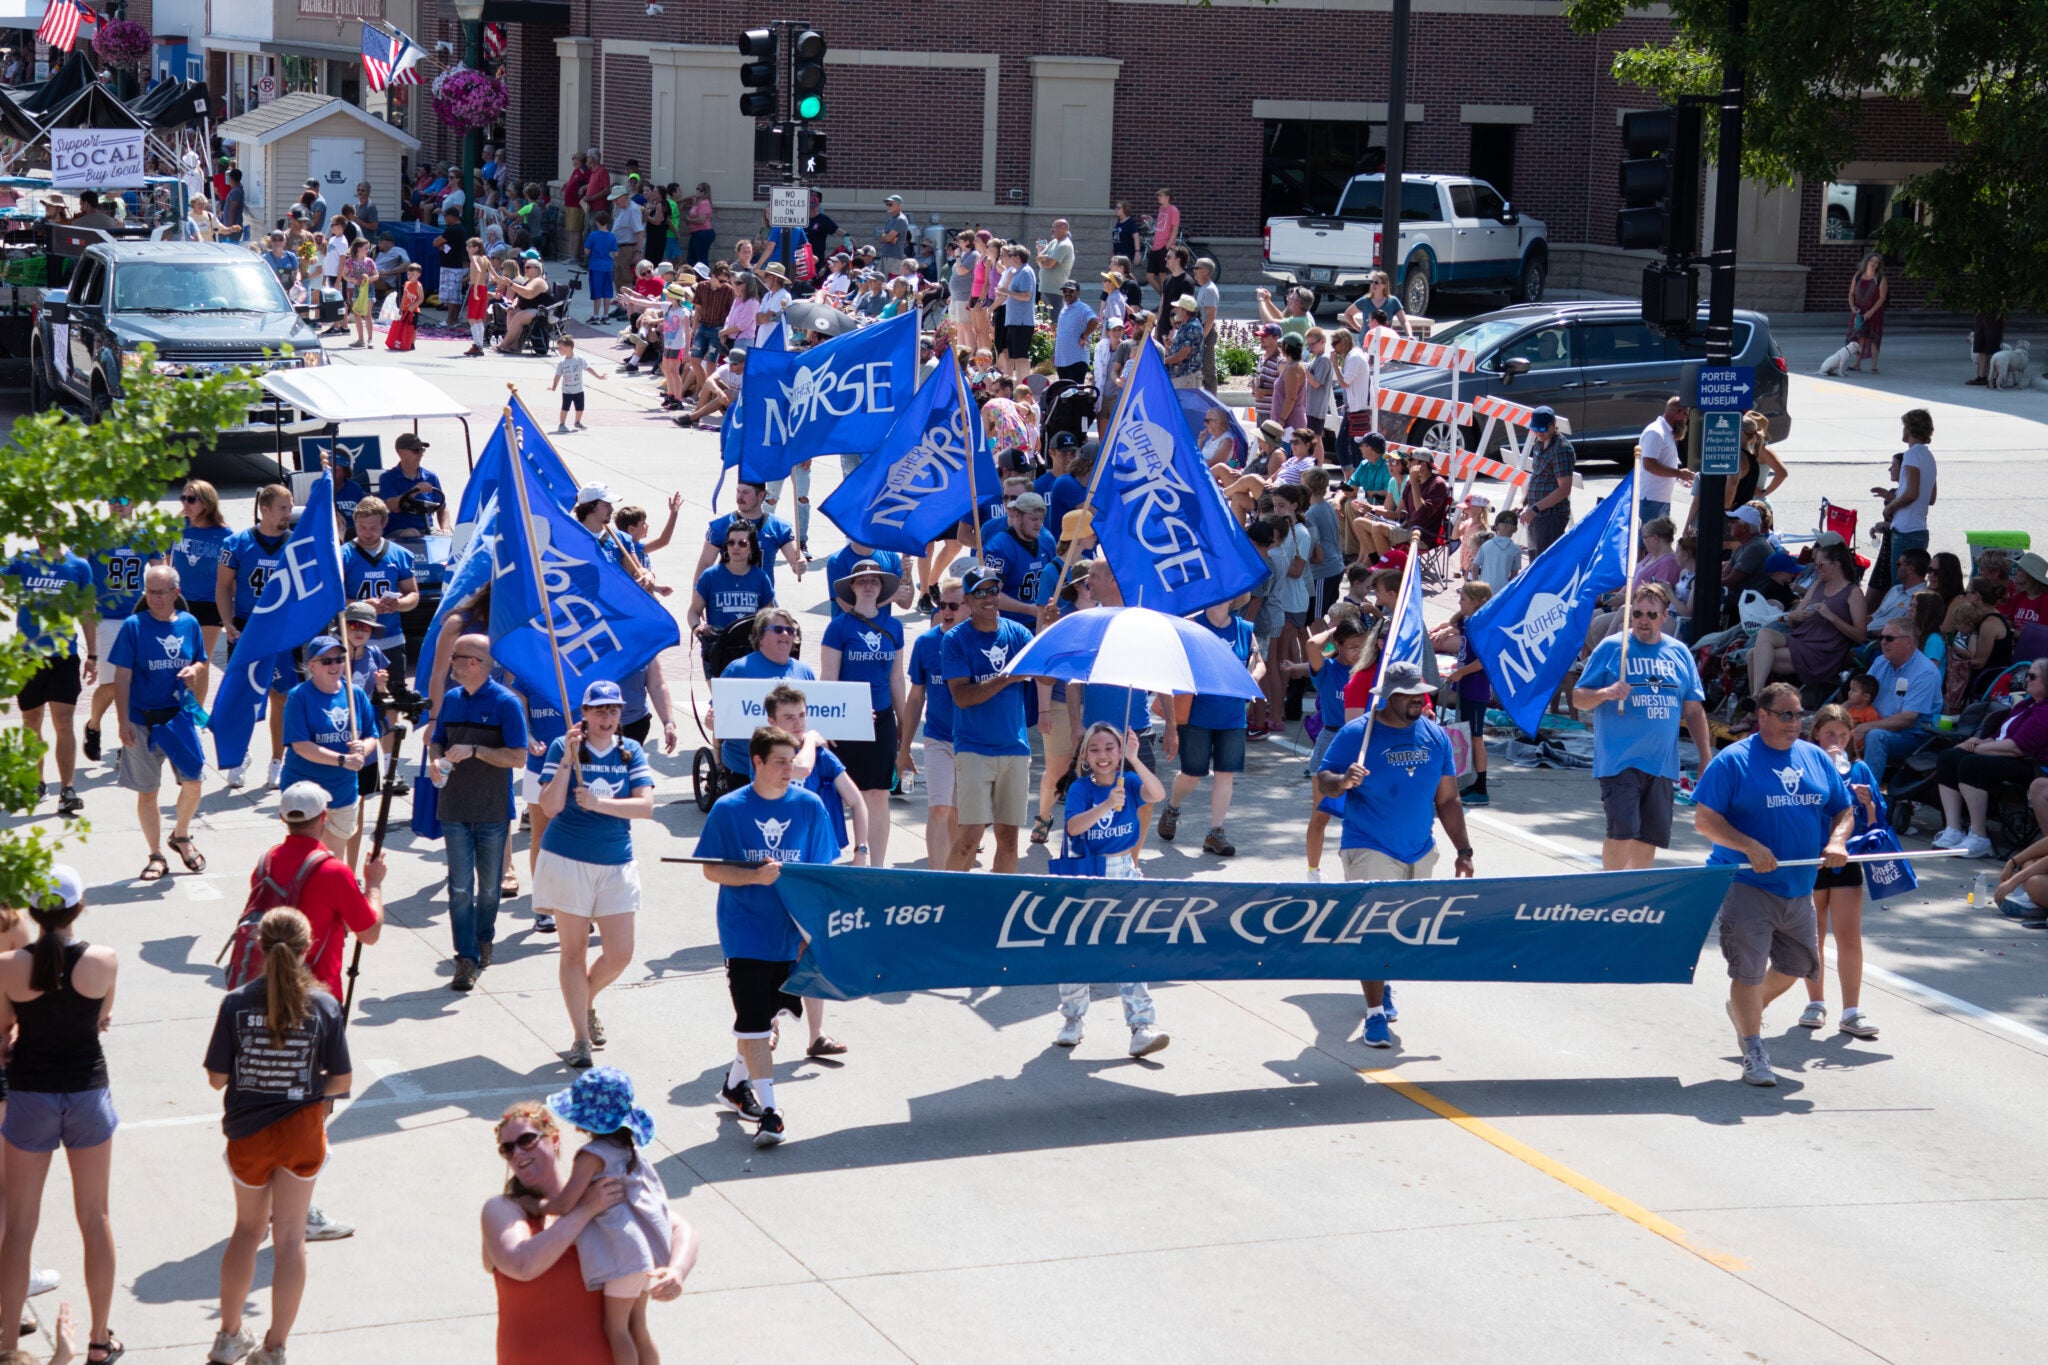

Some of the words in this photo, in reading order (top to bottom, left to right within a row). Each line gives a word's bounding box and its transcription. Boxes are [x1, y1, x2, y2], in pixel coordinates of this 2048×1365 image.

[55, 134, 100, 153] Support
[56, 144, 138, 170] LOCAL
[85, 168, 108, 183] Buy
[111, 161, 141, 178] Local
[785, 190, 795, 198] NO
[774, 199, 806, 207] BICYCLES
[773, 216, 805, 224] SIDEWALK
[1701, 372, 1737, 381] PORTER
[1701, 384, 1731, 393] HOUSE
[1700, 396, 1738, 405] MUSEUM
[1125, 424, 1163, 475] LUTHER
[108, 557, 141, 591] 82
[364, 570, 385, 579] NORSE
[1526, 603, 1567, 640] LUTHER
[848, 650, 875, 661] LUTHER
[149, 659, 173, 671] LUTHER
[1626, 657, 1677, 677] LUTHER
[1647, 706, 1670, 719] OPEN
[316, 731, 341, 744] LUTHER
[1386, 750, 1430, 764] NORSE
[1766, 794, 1792, 808] LUTHER
[1792, 793, 1823, 806] COLLEGE
[1104, 822, 1133, 838] COLLEGE
[771, 848, 801, 862] COLLEGE
[1870, 860, 1897, 876] LUTHER
[1872, 867, 1902, 885] COLLEGE
[828, 907, 871, 938] Est.
[883, 904, 945, 926] 1861
[996, 889, 1219, 949] LUTHER
[1229, 894, 1480, 946] COLLEGE
[1514, 903, 1666, 925] Luther.edu
